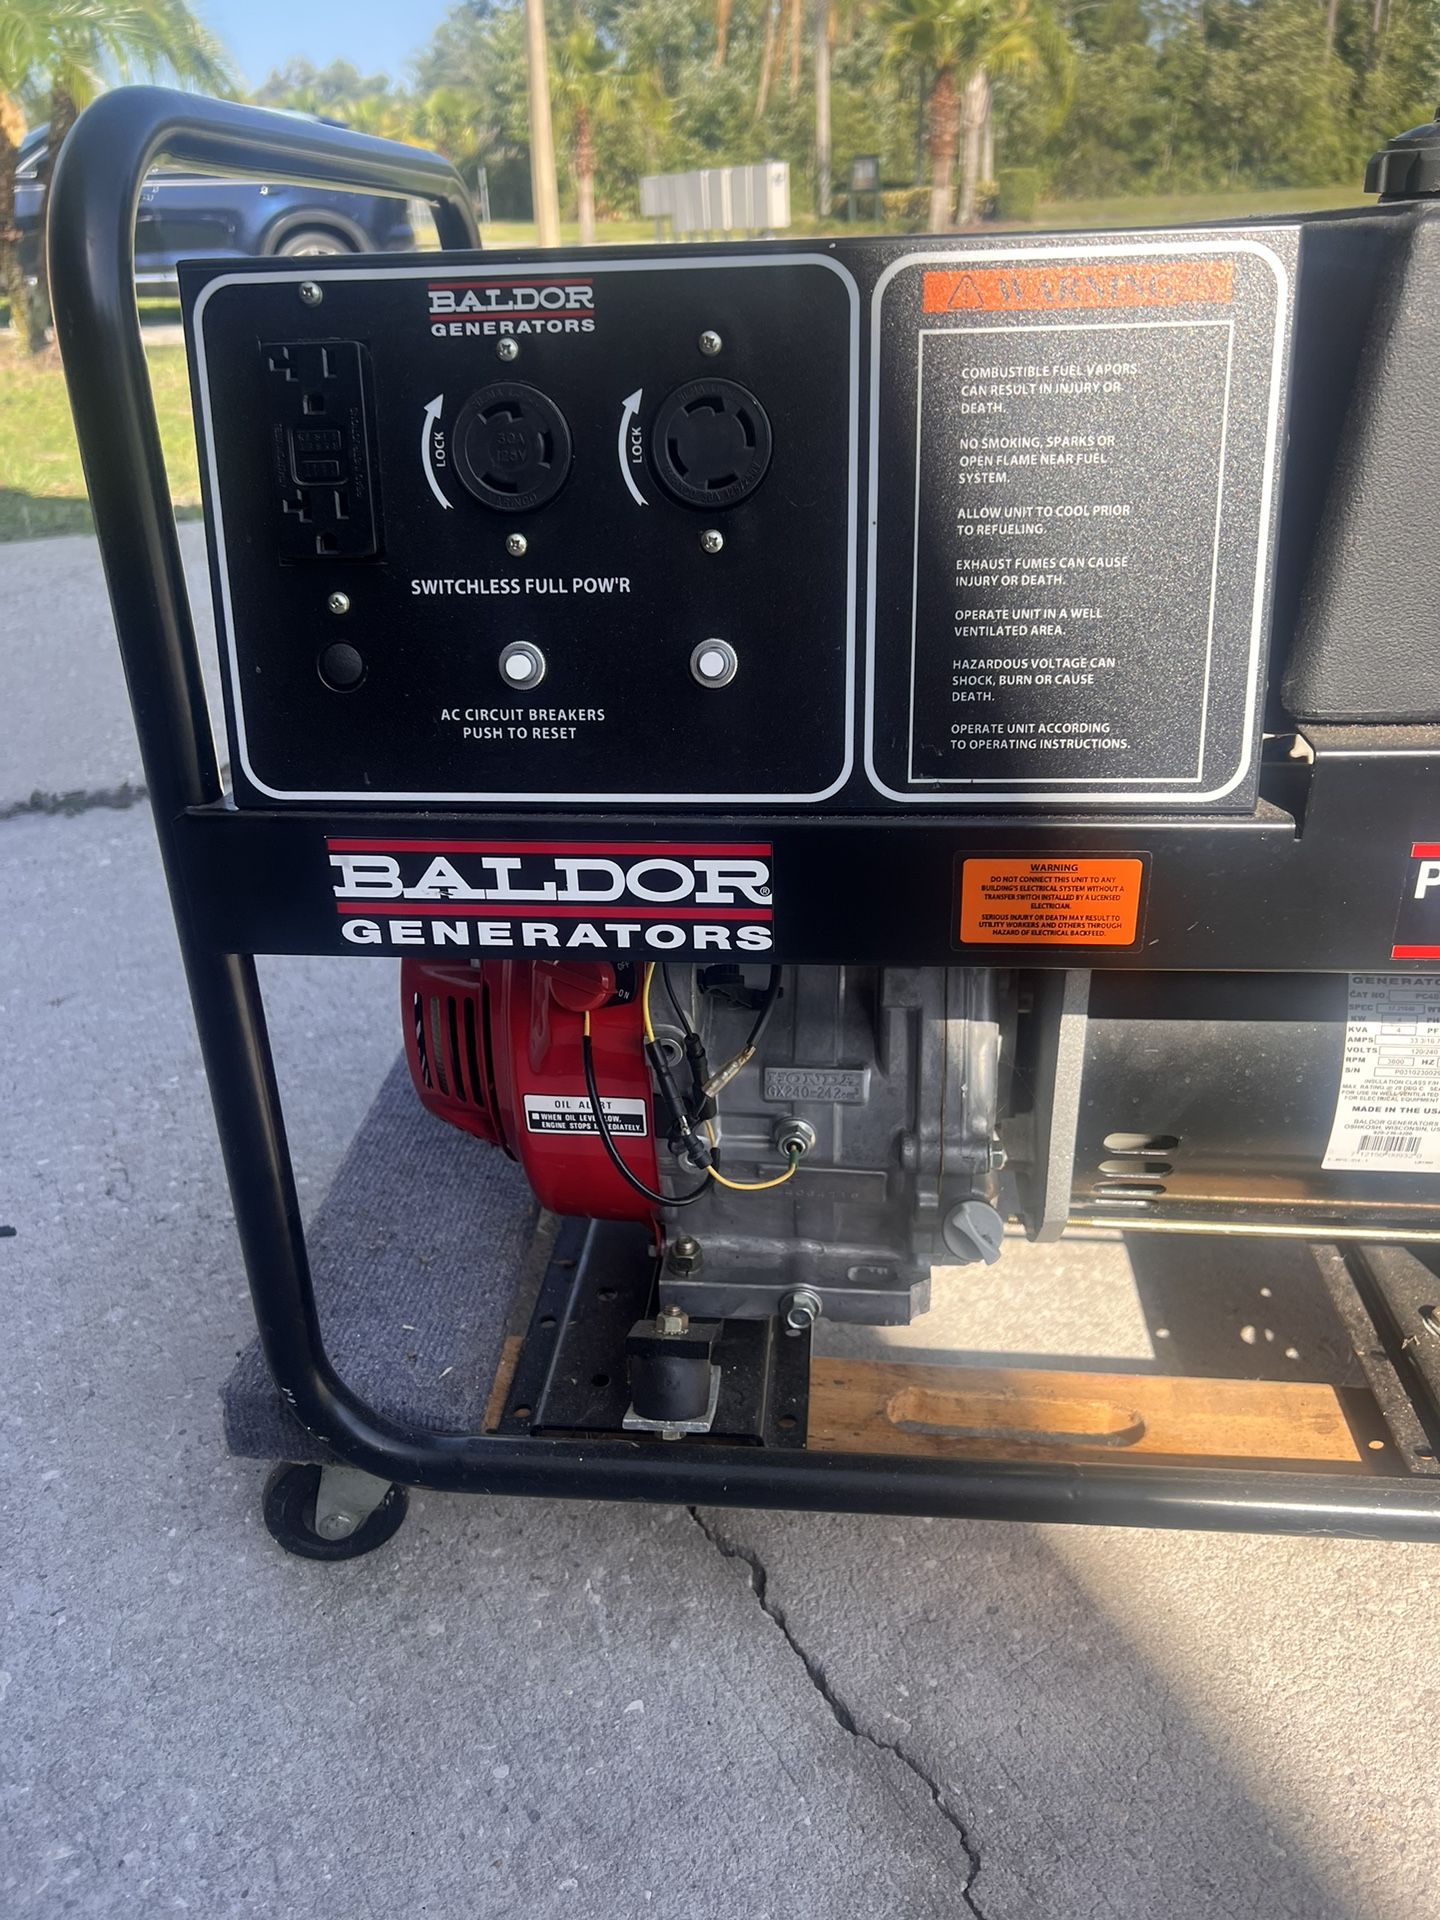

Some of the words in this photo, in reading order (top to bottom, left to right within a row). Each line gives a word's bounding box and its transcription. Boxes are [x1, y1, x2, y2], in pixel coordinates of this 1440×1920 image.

[999, 273, 1173, 301] WARNING
[428, 286, 595, 313] BALDOR
[431, 319, 595, 337] GENERATORS
[961, 366, 1050, 379] COMBUSTIBLE
[1053, 364, 1083, 377] FUEL
[1087, 363, 1138, 376] VAPORS
[962, 385, 987, 397] CAN
[991, 384, 1036, 396] RESULT
[1040, 383, 1051, 394] IN
[1054, 382, 1099, 394] INJURY
[1103, 381, 1121, 393] OR
[961, 402, 1006, 414] DEATH.
[631, 427, 644, 464] LOCK
[959, 438, 979, 450] NO
[982, 437, 1044, 449] SMOKING,
[1047, 436, 1095, 448] SPARKS
[1097, 435, 1115, 447] OR
[433, 431, 446, 468] LOCK
[960, 455, 993, 468] OPEN
[997, 454, 1038, 466] FLAME
[1040, 453, 1077, 465] NEAR
[1077, 453, 1108, 464] FUEL
[958, 473, 1010, 485] SYSTEM.
[957, 507, 1000, 519] ALLOW
[1004, 506, 1034, 518] UNIT
[1037, 506, 1053, 517] TO
[1056, 505, 1090, 517] COOL
[1093, 504, 1130, 516] PRIOR
[957, 525, 974, 536] TO
[976, 524, 1047, 535] REFUELING.
[956, 559, 1012, 570] EXHAUST
[1015, 558, 1056, 569] FUMES
[1059, 557, 1085, 568] CAN
[1088, 556, 1129, 567] CAUSE
[411, 579, 521, 595] SWITCHLESS
[525, 578, 568, 594] FULL
[572, 577, 631, 593] POW'R
[956, 575, 998, 586] INJURY
[1001, 575, 1018, 586] OR
[1021, 575, 1066, 586] DEATH.
[955, 609, 1009, 621] OPERATE
[1012, 609, 1041, 620] UNIT
[1044, 608, 1057, 619] IN
[1059, 608, 1068, 619] A
[1071, 608, 1103, 619] WELL
[954, 625, 1028, 637] VENTILATED
[1030, 625, 1066, 636] AREA.
[953, 658, 1028, 670] HAZARDOUS
[1031, 658, 1087, 669] VOLTAGE
[1090, 657, 1116, 668] CAN
[952, 675, 996, 687] SHOCK,
[1000, 675, 1032, 686] BURN
[1035, 675, 1051, 685] OR
[1054, 674, 1095, 685] CAUSE
[952, 692, 995, 702] DEATH.
[441, 709, 461, 721] AC
[465, 709, 524, 721] CIRCUIT
[529, 709, 606, 721] BREAKERS
[463, 727, 503, 739] PUSH
[507, 727, 528, 739] TO
[532, 727, 577, 739] RESET
[951, 723, 1004, 734] OPERATE
[1007, 723, 1036, 734] UNIT
[1038, 723, 1110, 734] ACCORDING
[950, 739, 966, 750] TO
[969, 739, 1037, 750] OPERATING
[1040, 738, 1131, 750] INSTRUCTIONS.
[1030, 864, 1078, 872] WARNING
[329, 855, 773, 905] BALDOR
[341, 919, 773, 952] GENERATORS
[618, 989, 630, 1000] ON
[1346, 1056, 1366, 1064] RPM
[554, 1100, 572, 1109] OIL
[578, 1100, 612, 1110] ALRT
[541, 1112, 562, 1120] WHEN
[565, 1113, 576, 1121] OIL
[570, 1122, 592, 1130] STOPS
